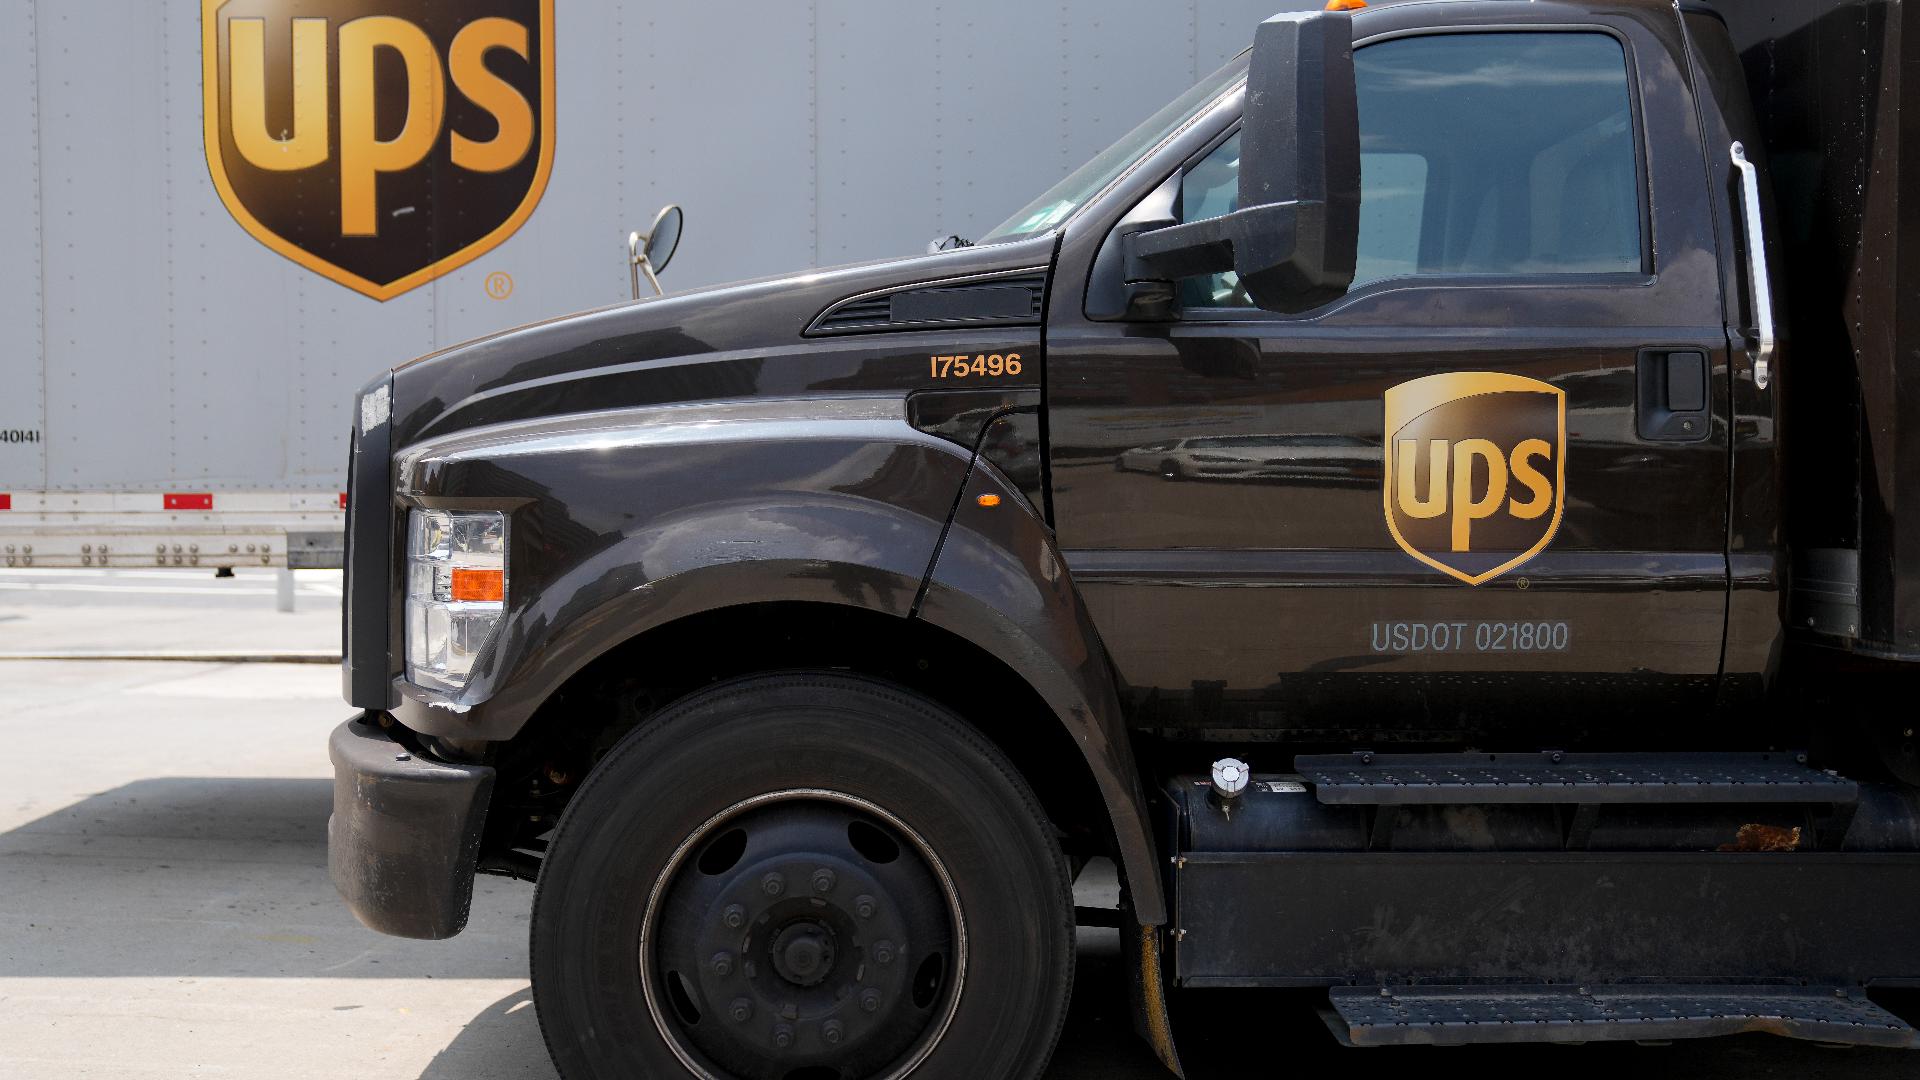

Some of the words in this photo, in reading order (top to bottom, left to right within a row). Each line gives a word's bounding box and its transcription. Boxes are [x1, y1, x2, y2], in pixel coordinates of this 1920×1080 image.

[228, 15, 536, 238] ups
[1398, 438, 1553, 552] ups
[1372, 622, 1468, 651] USDOT
[1475, 622, 1568, 651] 021800
